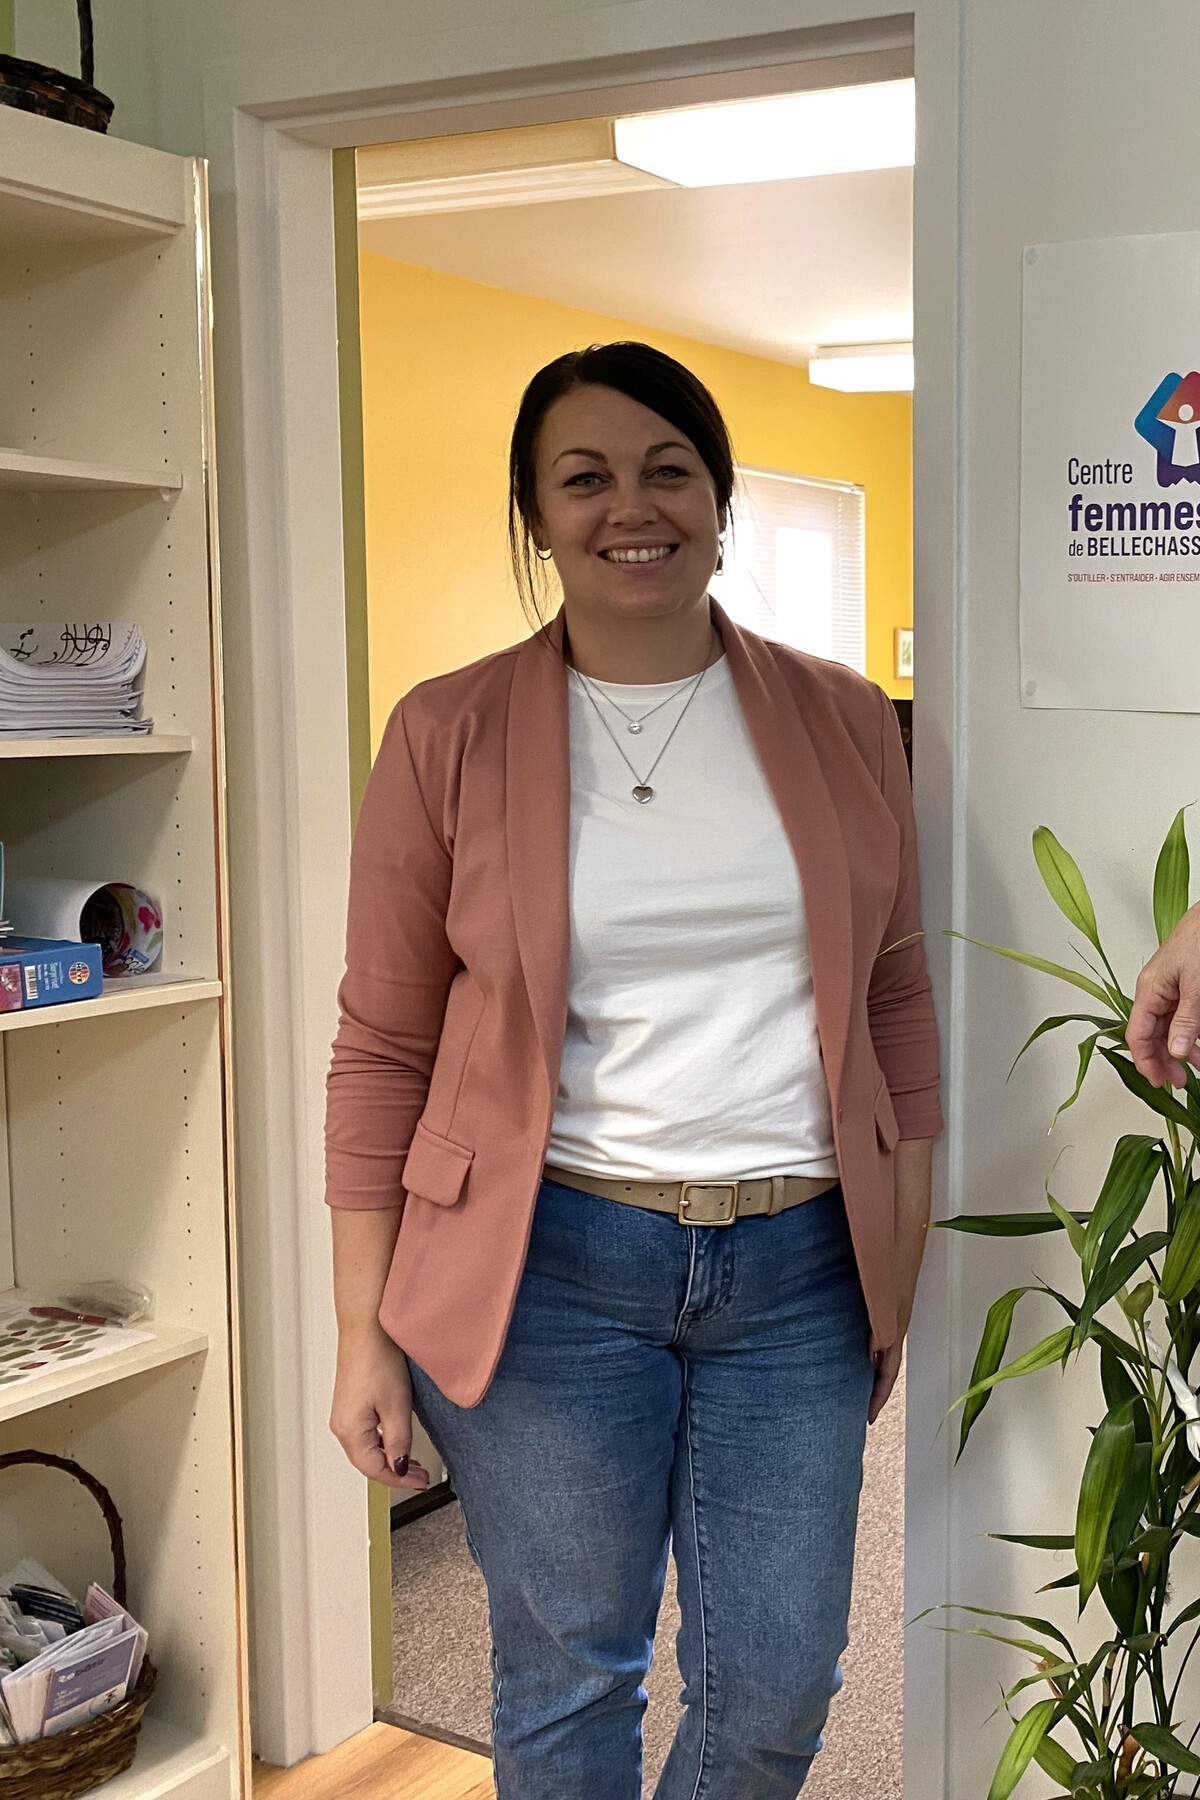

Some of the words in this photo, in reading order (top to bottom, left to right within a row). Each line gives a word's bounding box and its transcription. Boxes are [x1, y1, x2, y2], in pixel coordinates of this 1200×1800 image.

[1068, 457, 1133, 485] Centre
[1068, 539, 1084, 557] de
[1067, 573, 1106, 583] S'OUTILLER
[1110, 573, 1154, 583] S'ENTRAIDER
[1159, 573, 1176, 582] AGIR
